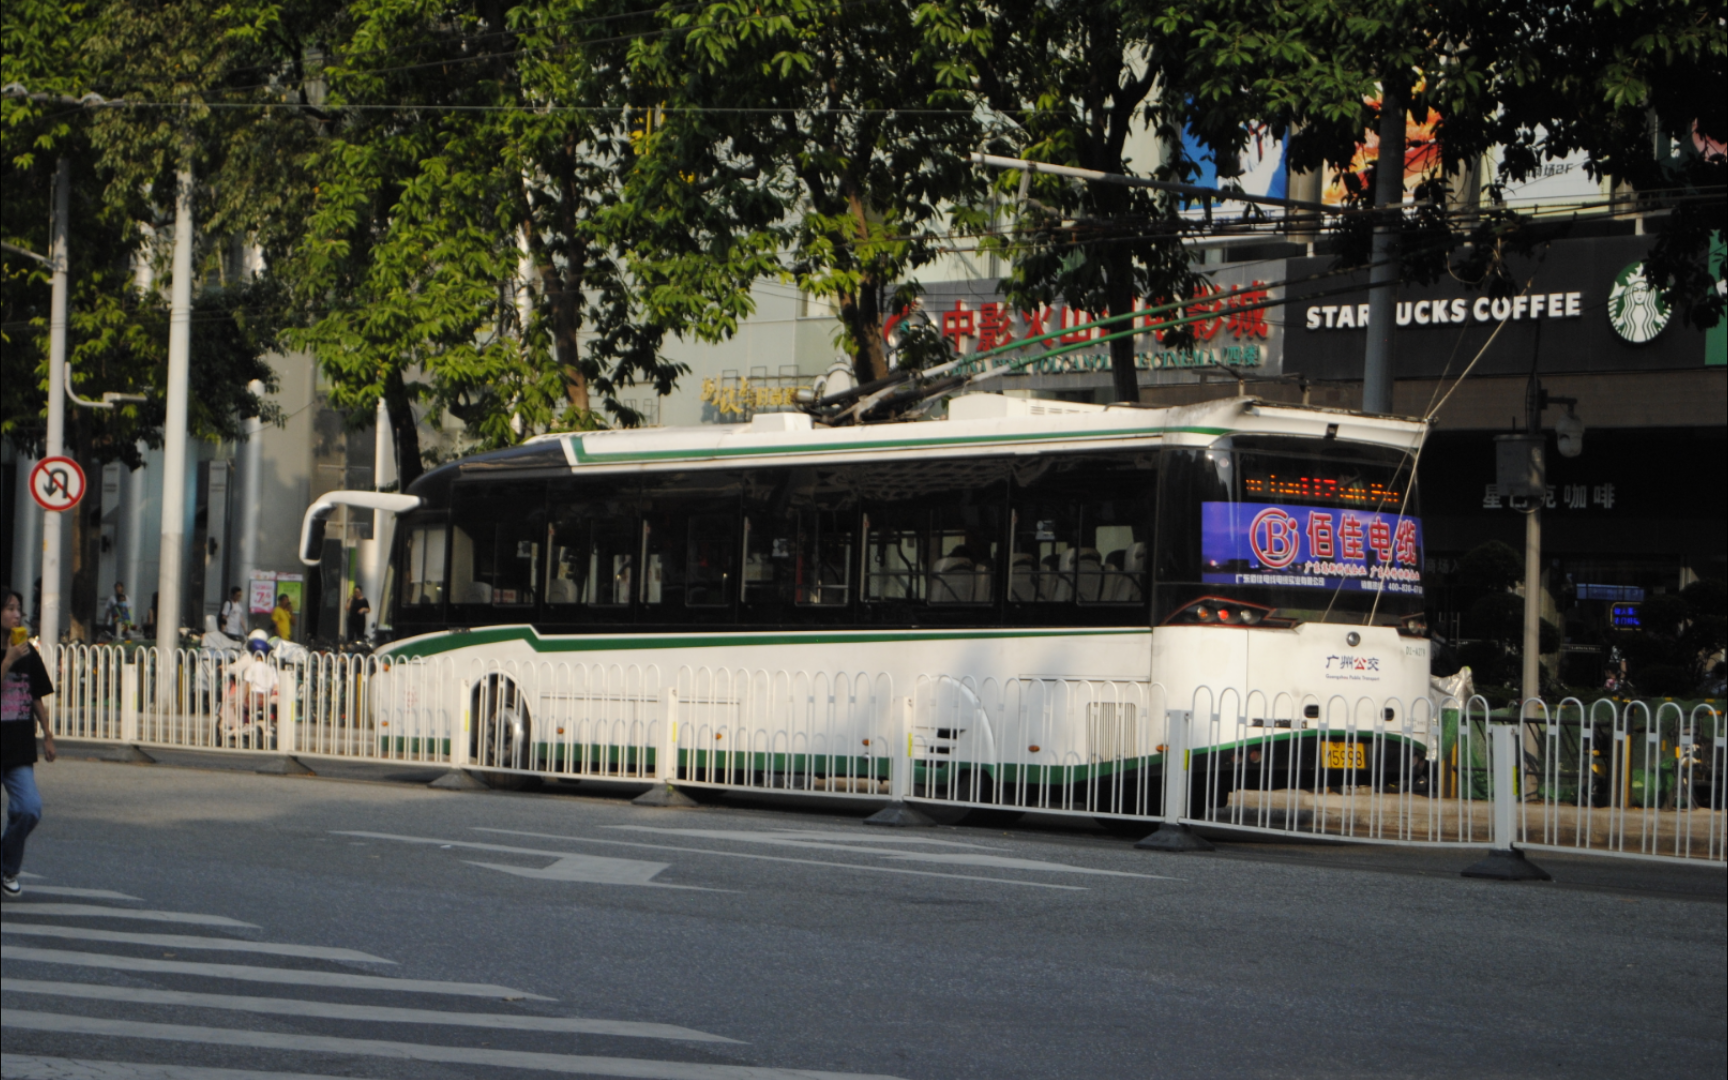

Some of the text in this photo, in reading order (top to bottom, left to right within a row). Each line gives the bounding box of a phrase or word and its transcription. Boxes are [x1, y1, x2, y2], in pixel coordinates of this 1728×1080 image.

[1305, 291, 1582, 331] STARUCKS COFFEE
[1305, 510, 1418, 566] 佰佳电缆
[1325, 654, 1380, 672] 广州公交
